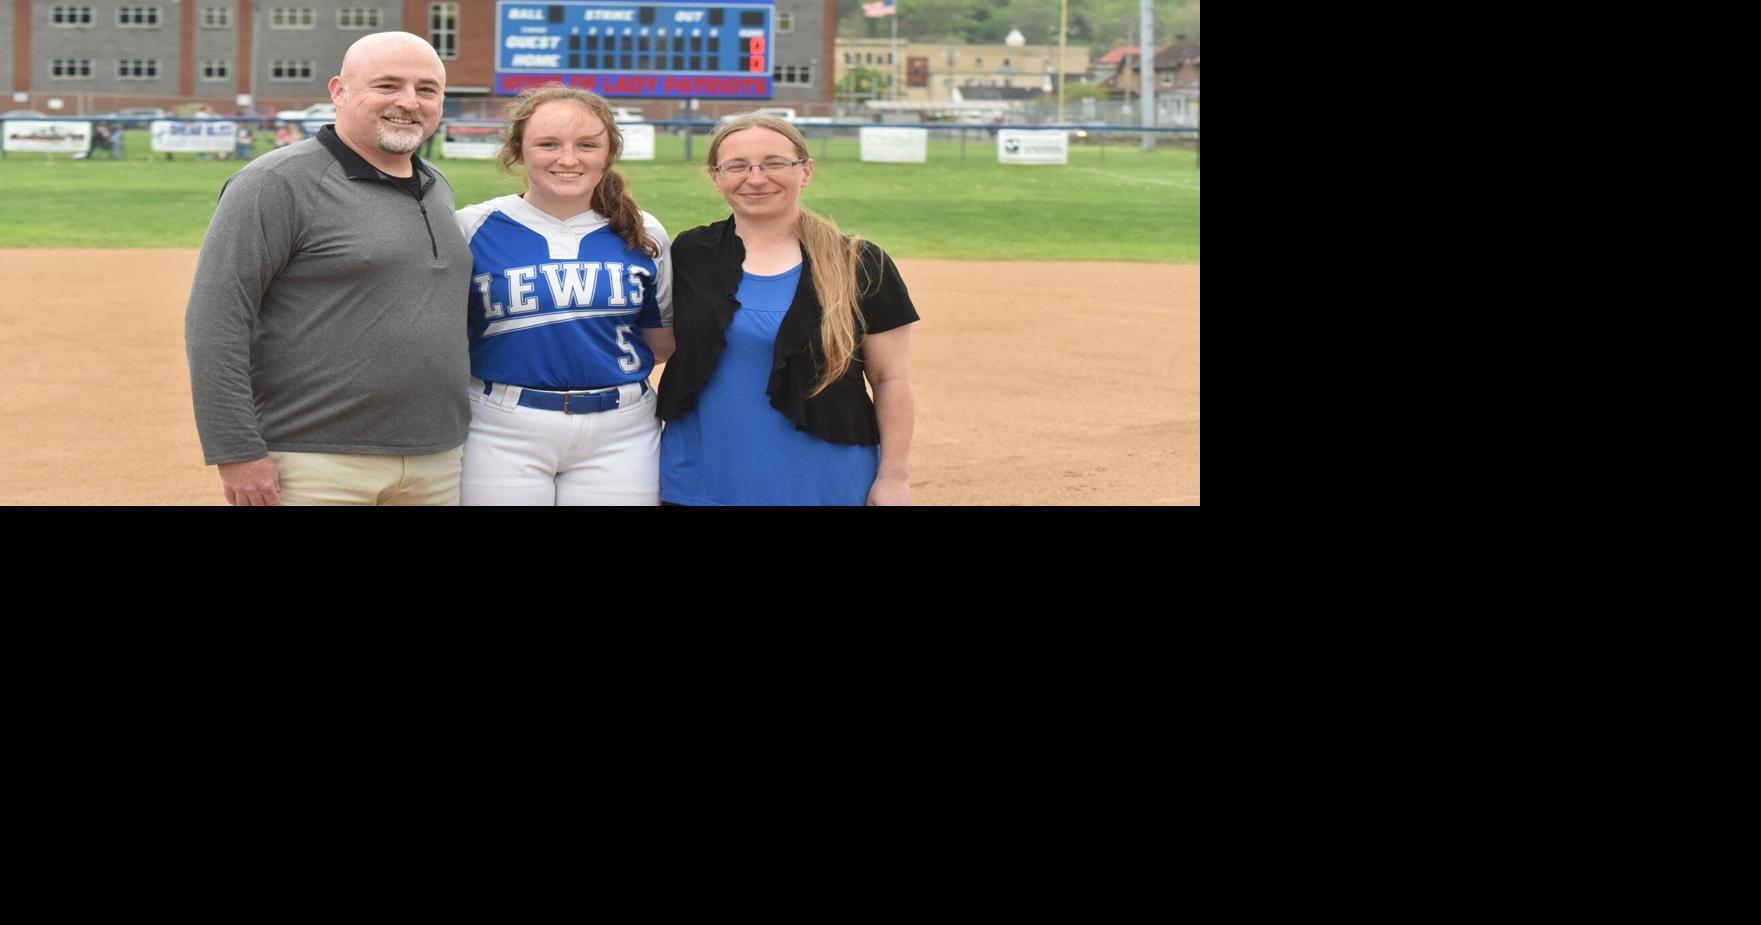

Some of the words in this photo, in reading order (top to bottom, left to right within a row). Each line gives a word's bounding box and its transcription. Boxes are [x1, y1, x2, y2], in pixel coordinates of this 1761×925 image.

[508, 9, 545, 21] BALL
[584, 9, 635, 22] STRIKE
[674, 11, 704, 22] OUT
[505, 35, 561, 49] GUEST
[750, 37, 765, 54] 0
[511, 54, 561, 67] HOME
[750, 55, 765, 72] 0
[603, 77, 659, 95] LADY
[664, 77, 768, 95] PATRIOTS
[473, 262, 651, 320] LEWIS
[615, 323, 642, 374] 5
